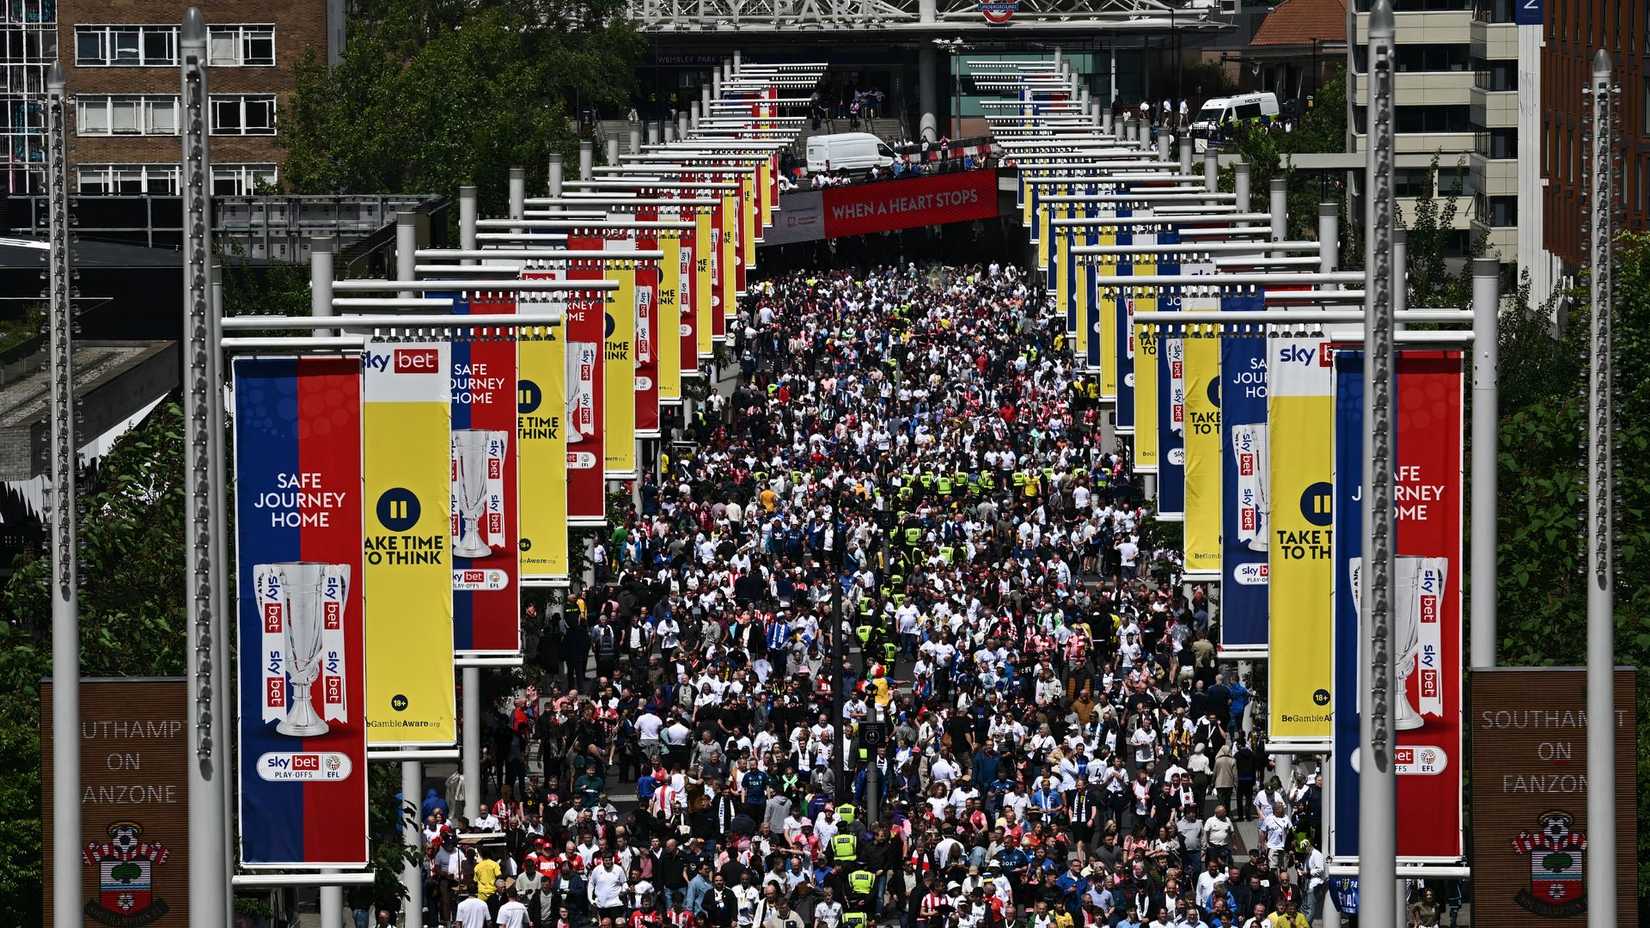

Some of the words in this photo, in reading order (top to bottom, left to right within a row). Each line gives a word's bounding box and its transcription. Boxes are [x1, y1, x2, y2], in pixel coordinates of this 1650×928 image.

[831, 203, 875, 219] WHEN
[877, 201, 888, 215] A
[890, 193, 933, 213] HEART
[935, 189, 978, 205] STOPS
[398, 351, 435, 368] bet
[1250, 358, 1267, 370] SA
[1279, 344, 1316, 366] sky
[454, 363, 488, 376] SAFE
[450, 377, 505, 390] OURNEY
[1246, 386, 1267, 398] HO
[527, 416, 559, 428] TIME
[1194, 424, 1211, 435] TO
[488, 439, 500, 457] sky
[1240, 432, 1252, 452] sky
[489, 460, 500, 478] bet
[1242, 455, 1252, 475] bet
[277, 472, 322, 489] SAFE
[254, 492, 346, 508] JOURNEY
[1242, 488, 1253, 506] sky
[1351, 485, 1445, 501] JRNEY
[489, 494, 499, 512] sky
[271, 512, 330, 528] HOME
[490, 513, 500, 533] bet
[1244, 509, 1254, 529] bet
[364, 536, 398, 550] AKE
[402, 536, 443, 550] TIME
[1277, 530, 1323, 545] TAKE
[365, 551, 383, 565] O
[386, 551, 442, 565] THINK
[1281, 546, 1305, 560] TO
[465, 572, 483, 581] bet
[1242, 566, 1258, 576] sky
[265, 575, 281, 600] sky
[324, 576, 339, 600] sky
[1420, 570, 1436, 593] sky
[268, 605, 279, 631] bet
[327, 604, 338, 627] bet
[1423, 597, 1436, 621] bet
[267, 650, 283, 675] sky
[326, 650, 340, 674] sky
[1421, 644, 1436, 668] sky
[271, 679, 283, 706] bet
[329, 678, 340, 702] bet
[1424, 672, 1436, 696] bet
[393, 699, 407, 707] 18+
[81, 720, 188, 738] UTHAMP
[1537, 742, 1571, 760] ON
[106, 753, 141, 770] ON
[267, 756, 290, 770] sky
[294, 755, 318, 767] bet
[274, 771, 313, 779] PLAY-OFFS
[1503, 775, 1589, 793] FANZON
[81, 785, 177, 804] ANZONE
